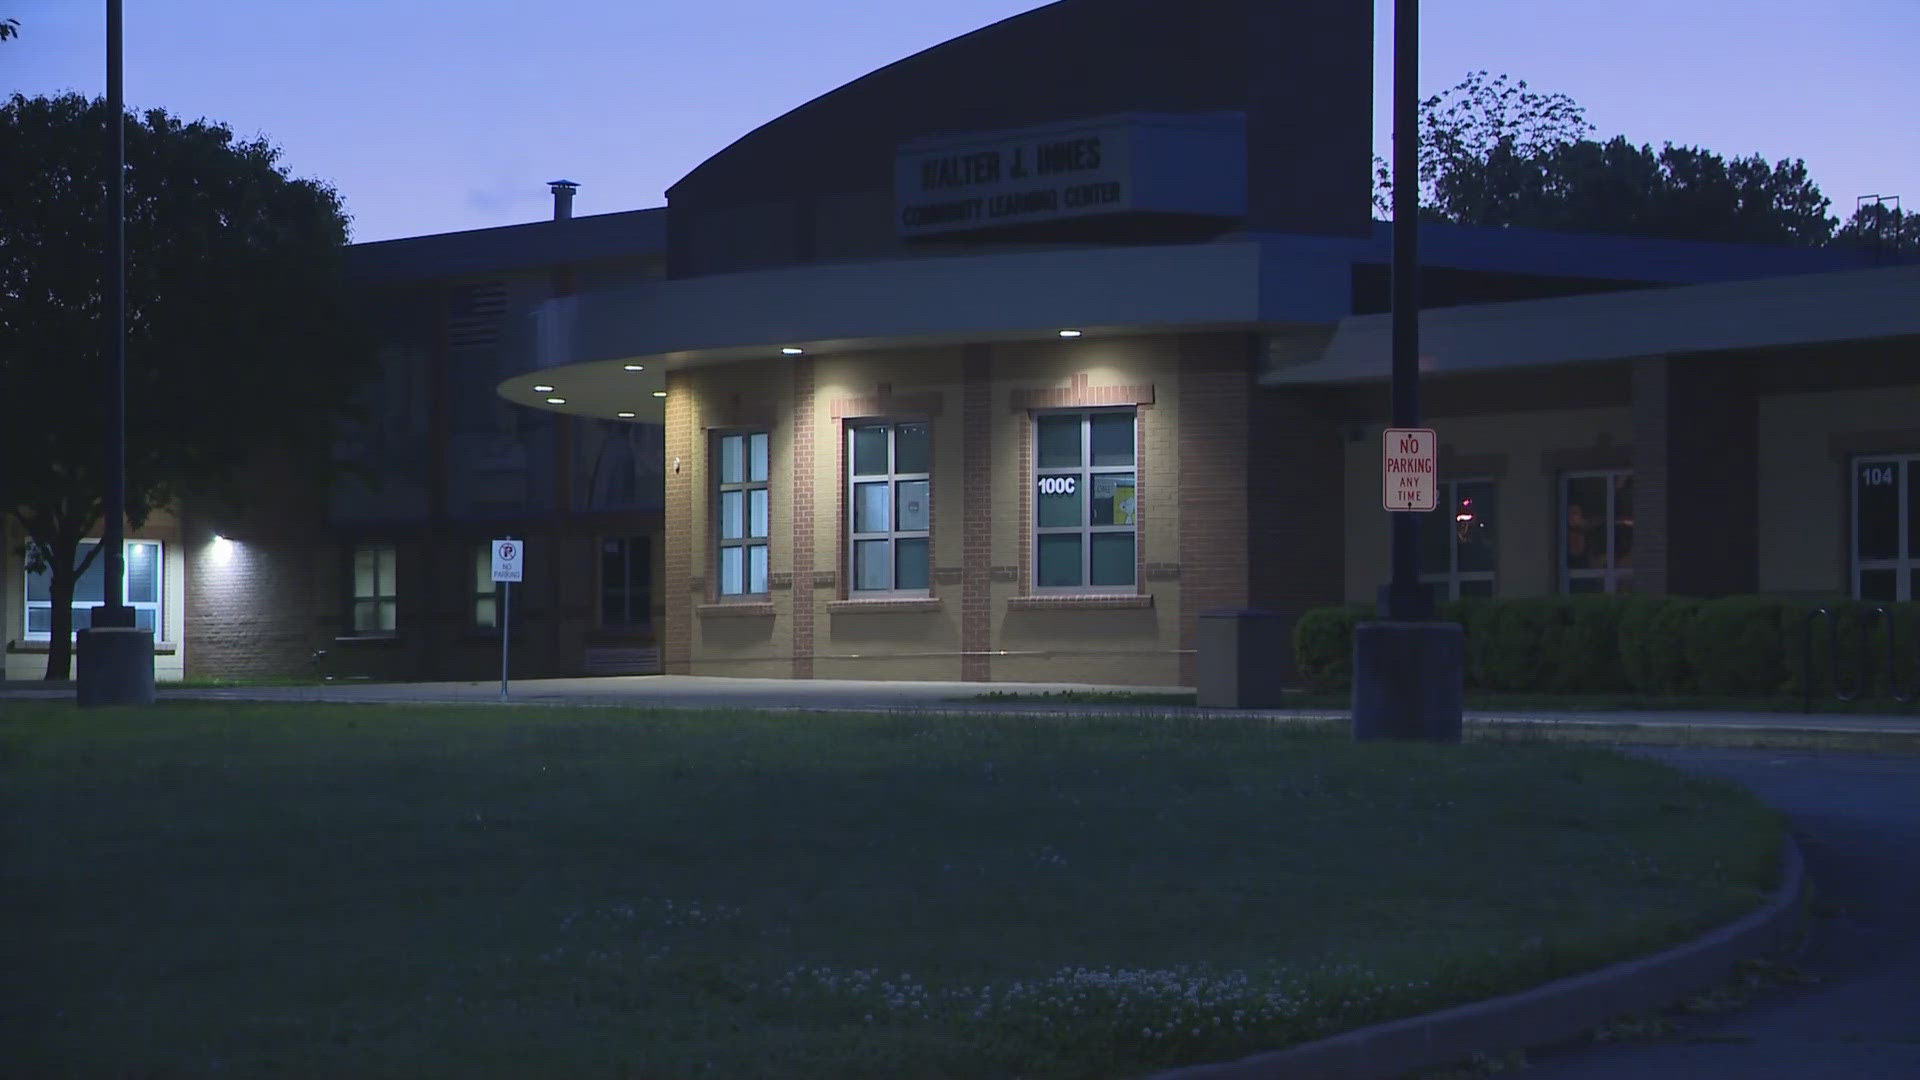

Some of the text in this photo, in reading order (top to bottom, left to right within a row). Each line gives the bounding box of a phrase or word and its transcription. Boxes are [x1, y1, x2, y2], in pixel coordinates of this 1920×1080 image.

[902, 196, 984, 225] COITY
[988, 190, 1058, 218] LEAR
[1400, 439, 1419, 454] NO
[1387, 458, 1432, 473] PARKING
[1400, 477, 1420, 487] ANY
[1862, 468, 1892, 486] 104
[1038, 477, 1075, 494] 100C
[1398, 491, 1421, 501] TIME
